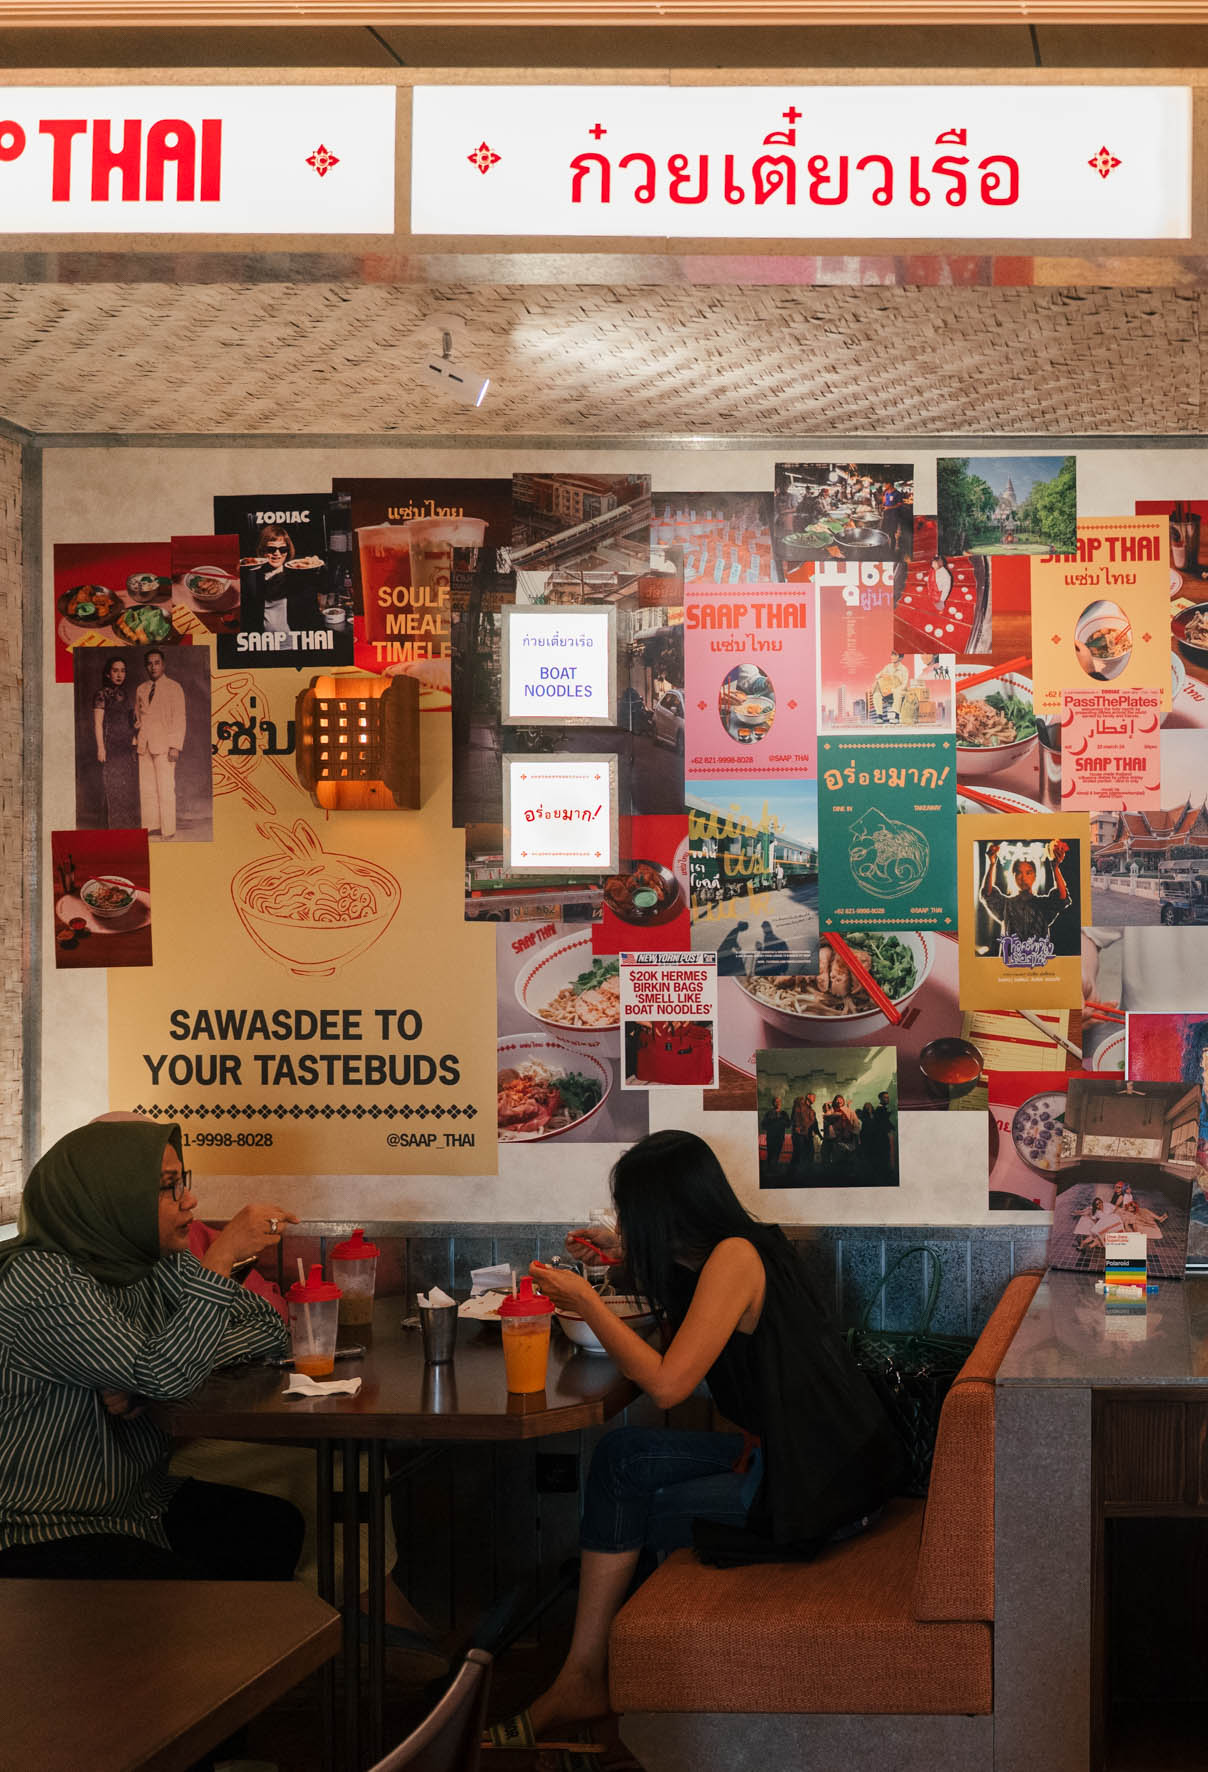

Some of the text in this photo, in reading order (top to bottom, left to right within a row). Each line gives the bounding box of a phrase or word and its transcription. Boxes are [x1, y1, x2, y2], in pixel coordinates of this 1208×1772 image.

[38, 119, 222, 202] THAI
[569, 106, 1020, 207] ก๋วยเตี๋ยวเรือ
[256, 510, 311, 525] ZODIAC
[1103, 536, 1160, 563] THAI
[377, 586, 450, 608] SOULF
[386, 614, 449, 635] MEAL
[686, 603, 807, 630] SAAP THAI
[236, 629, 334, 653] SAAP THAI
[371, 641, 452, 663] TIMELE
[540, 666, 577, 680] BOAT
[524, 684, 592, 698] NOODLES
[1064, 695, 1158, 708] PassThePlates
[1075, 757, 1147, 772] SAAP THAI
[629, 970, 708, 982] $20K HERMES
[633, 982, 703, 993] BIRKIN BAGS
[677, 993, 702, 1003] LIKE
[625, 1004, 654, 1015] BOAT
[169, 1009, 422, 1041] SAWASDEE TO
[143, 1054, 461, 1087] YOUR TASTEBUDS
[181, 1133, 273, 1148] 1-9998-8028
[386, 1133, 475, 1149] @SAAP_THAI
